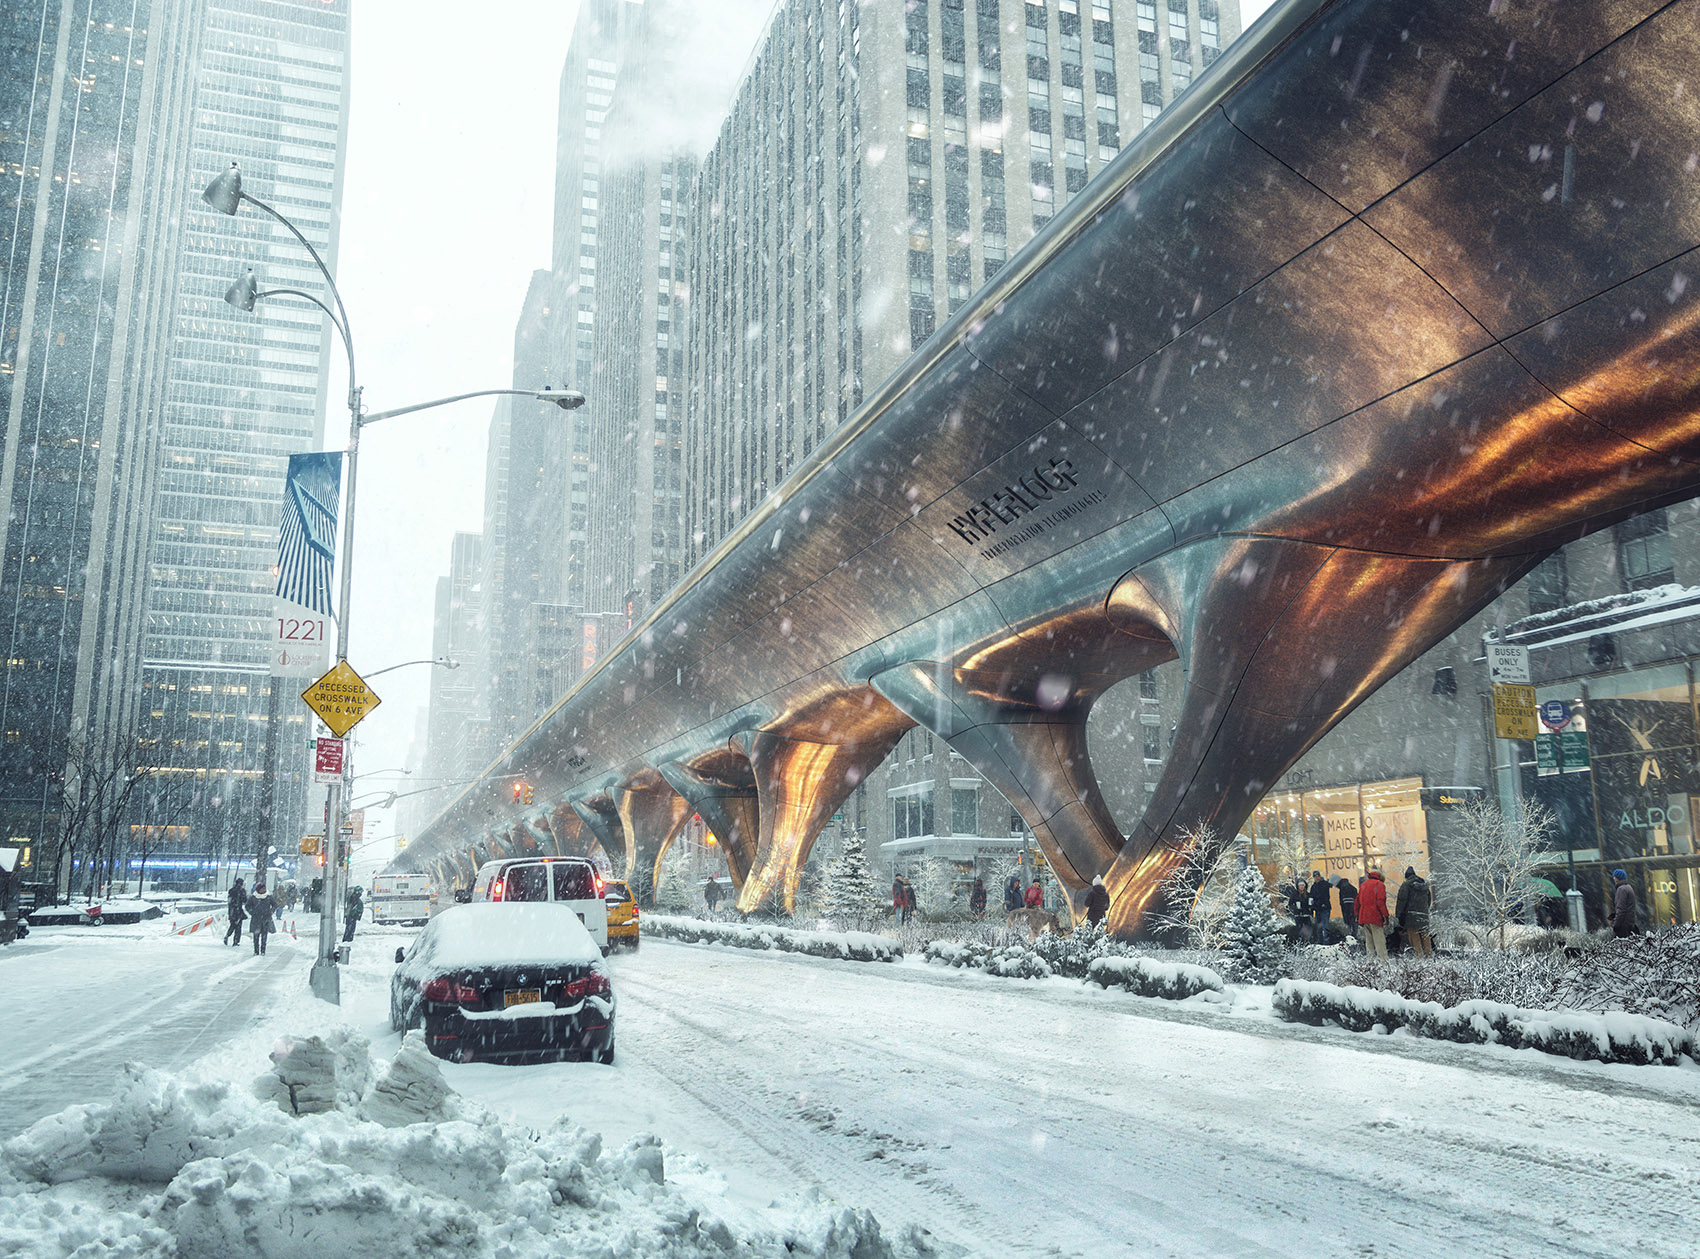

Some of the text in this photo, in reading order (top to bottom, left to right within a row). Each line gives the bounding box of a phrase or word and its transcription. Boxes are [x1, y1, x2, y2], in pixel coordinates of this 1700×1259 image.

[947, 456, 1079, 545] HYPERLOOP
[278, 618, 323, 640] 1221
[1495, 648, 1521, 656] BUSES
[319, 683, 365, 693] RECESSED
[1496, 687, 1532, 698] CAUTION
[315, 693, 368, 704] CROSSWALK
[1497, 699, 1533, 708] RECESSED
[320, 704, 332, 713] ON
[1497, 708, 1534, 717] CROSSWALK
[1507, 726, 1512, 735] 6
[1286, 769, 1313, 784] LOFT
[1619, 805, 1685, 829] ALDO
[1327, 814, 1409, 832] MAKE OOKING
[1330, 857, 1357, 870] YOUR
[1648, 881, 1677, 893] LDO
